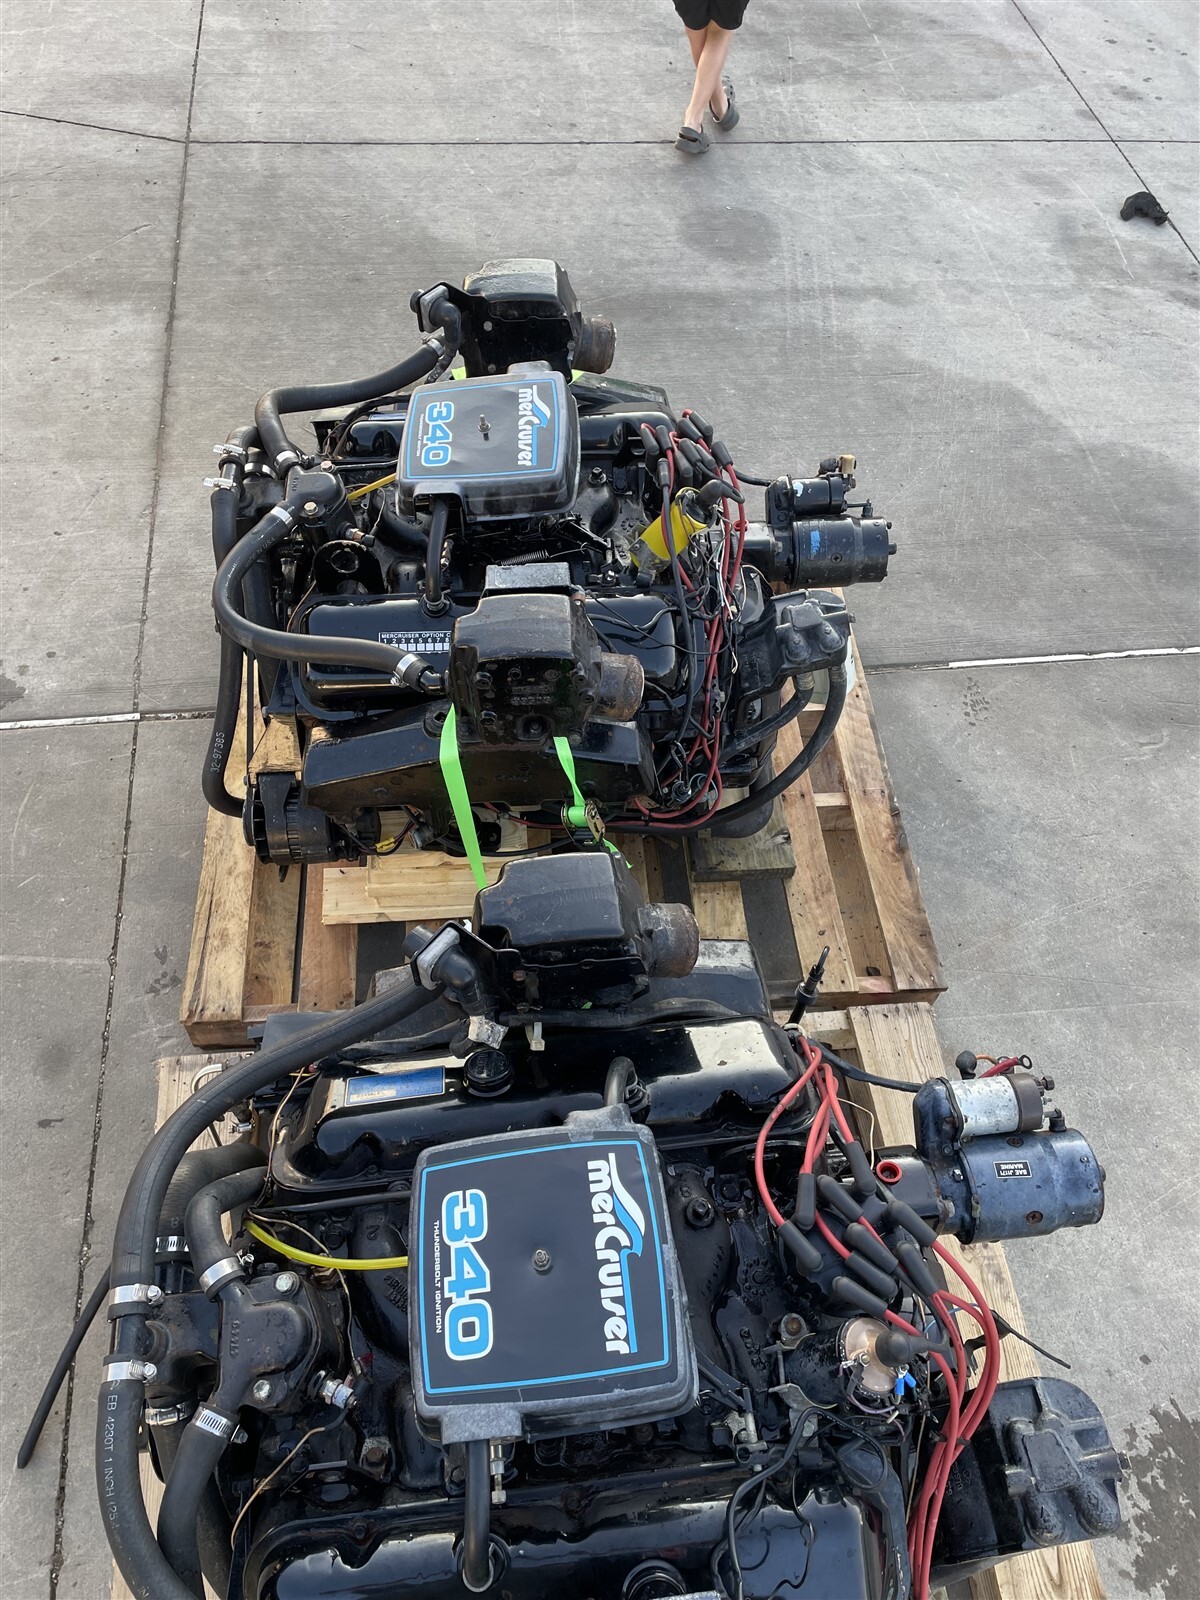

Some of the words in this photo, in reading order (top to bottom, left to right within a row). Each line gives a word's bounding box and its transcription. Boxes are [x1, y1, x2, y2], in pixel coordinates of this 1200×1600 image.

[422, 402, 455, 466] 340
[210, 731, 225, 773] 32-97385
[433, 1219, 441, 1288] THUNDERBOLT
[441, 1188, 494, 1361] 340
[434, 1290, 442, 1334] IGNITION
[107, 1394, 118, 1411] EB
[103, 1416, 115, 1452] 4230T
[104, 1467, 115, 1497] INCH
